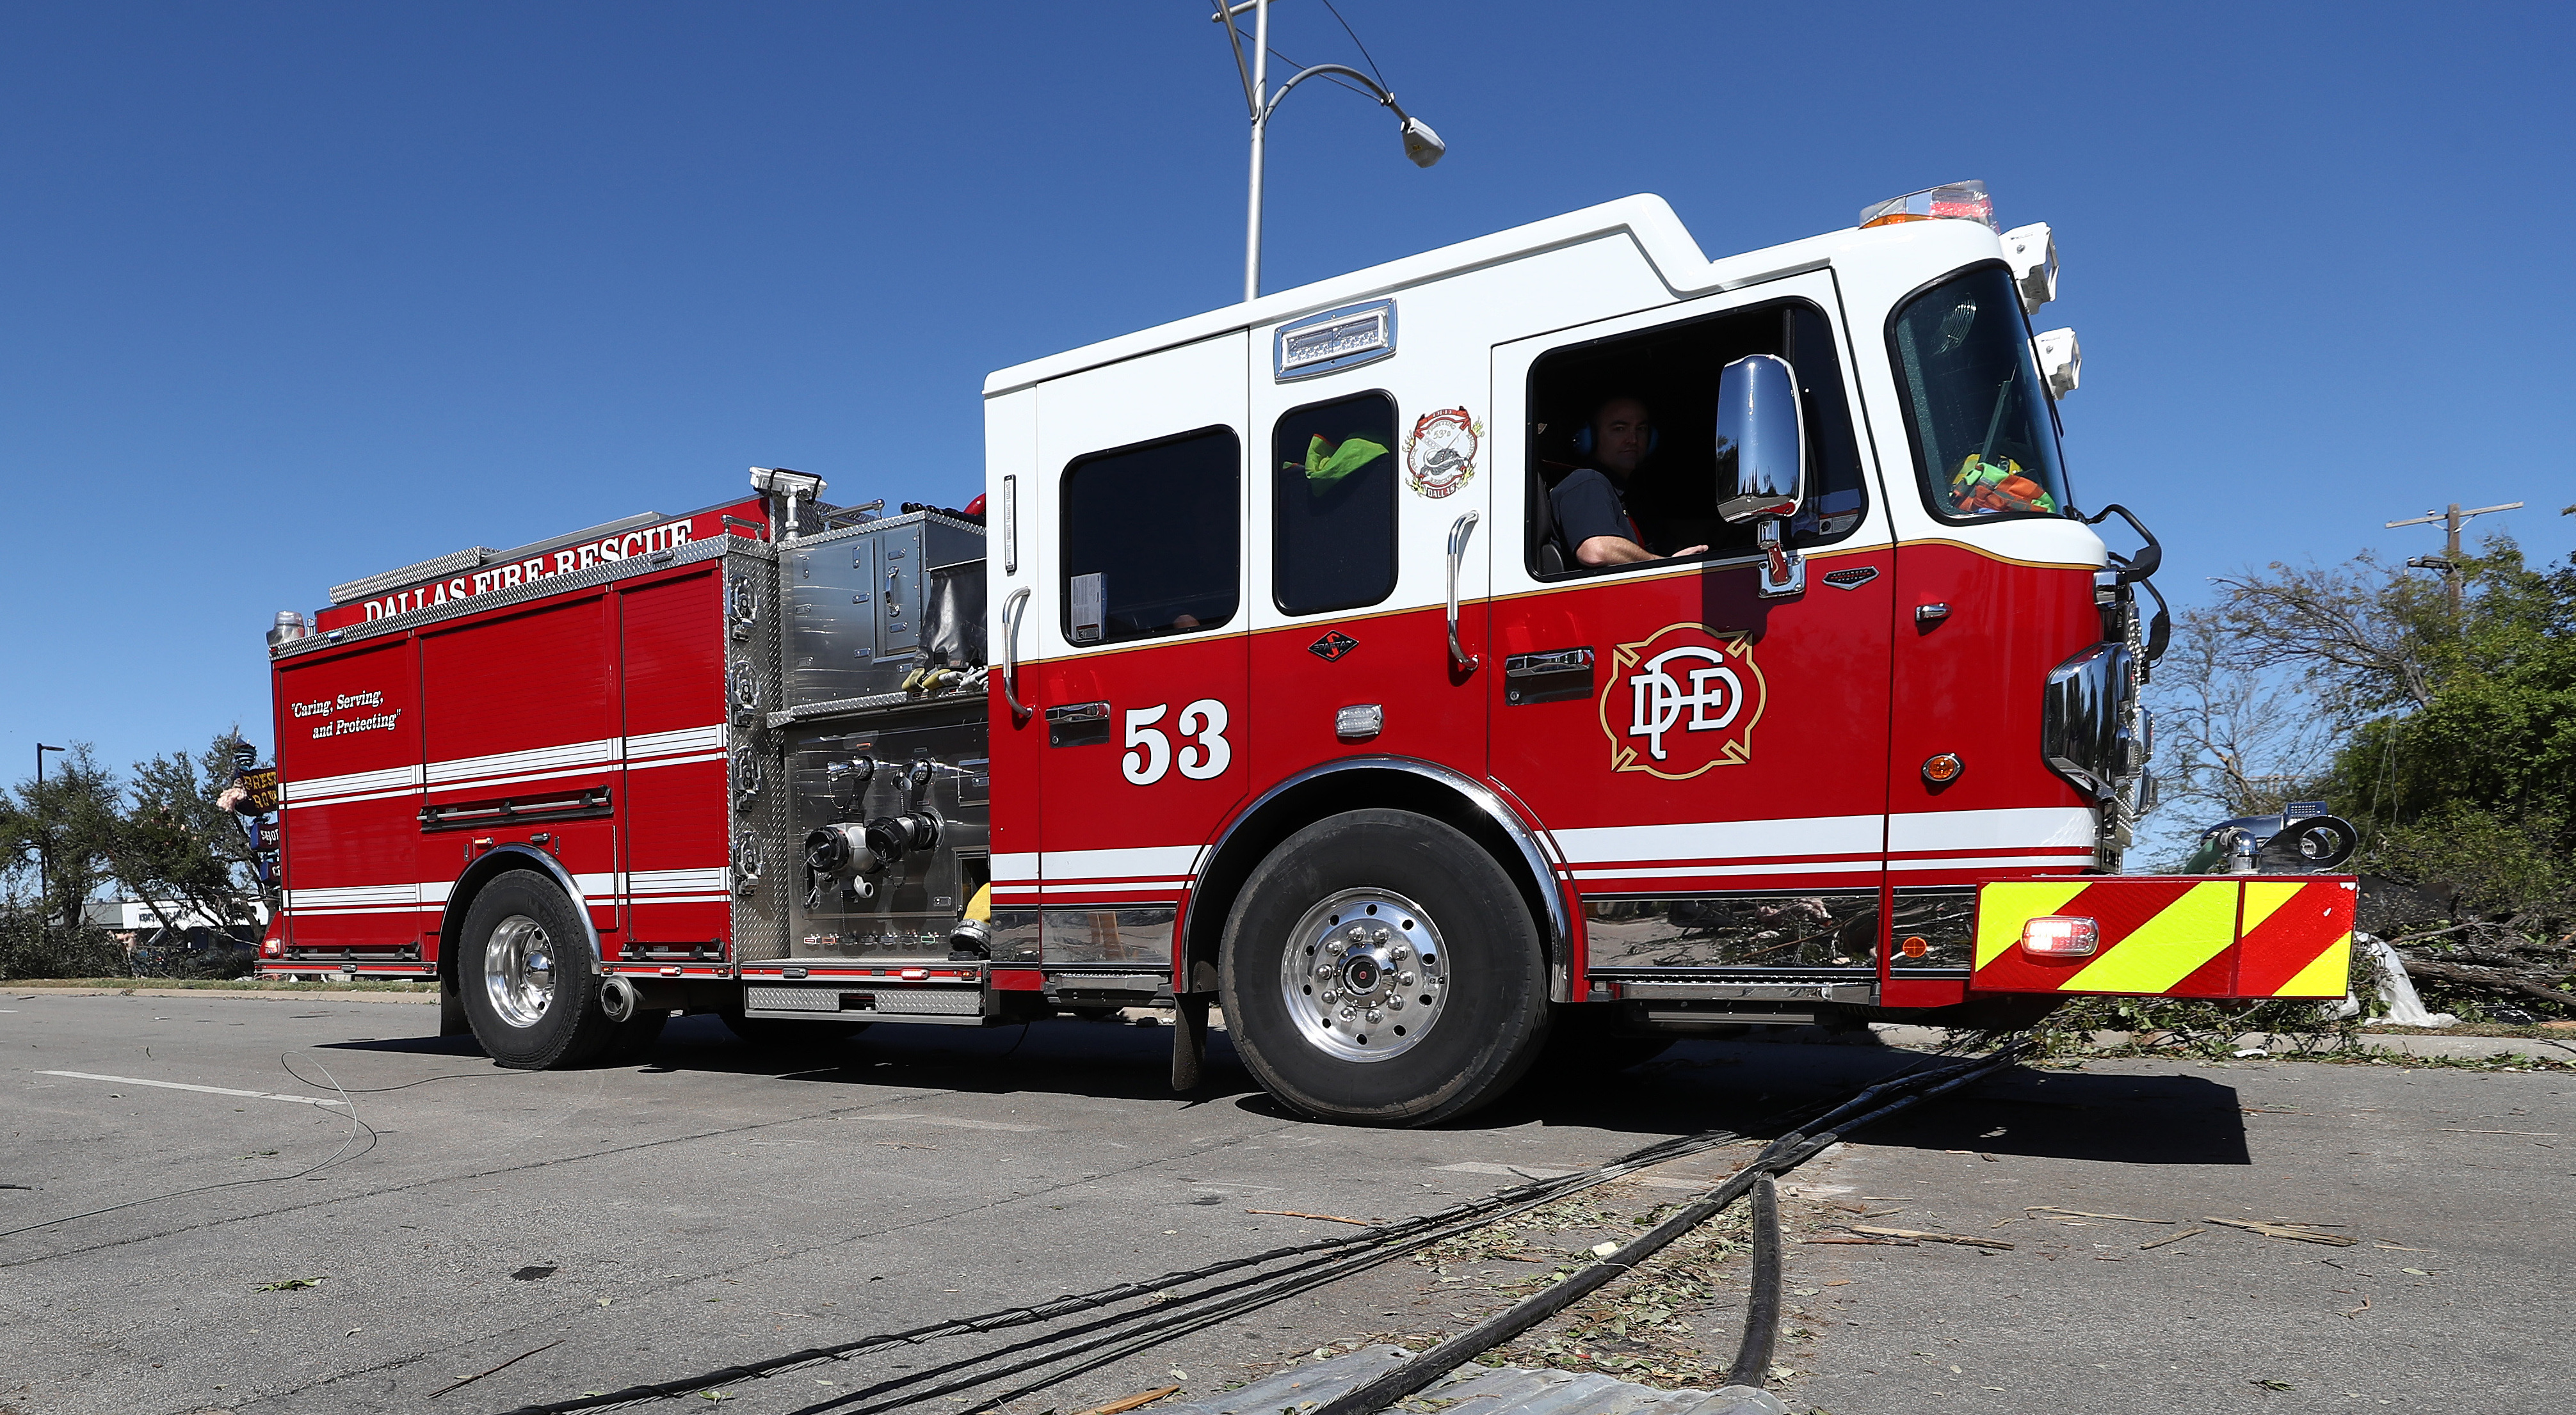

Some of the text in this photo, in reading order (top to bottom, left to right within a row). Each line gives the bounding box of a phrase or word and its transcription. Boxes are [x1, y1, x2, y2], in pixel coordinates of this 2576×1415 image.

[1428, 483, 1456, 497] DALLAS
[364, 577, 467, 623] DALLAS
[291, 690, 384, 718] "Caring, Serving,
[312, 708, 402, 739] and Protecting"
[1122, 698, 1232, 787] 53
